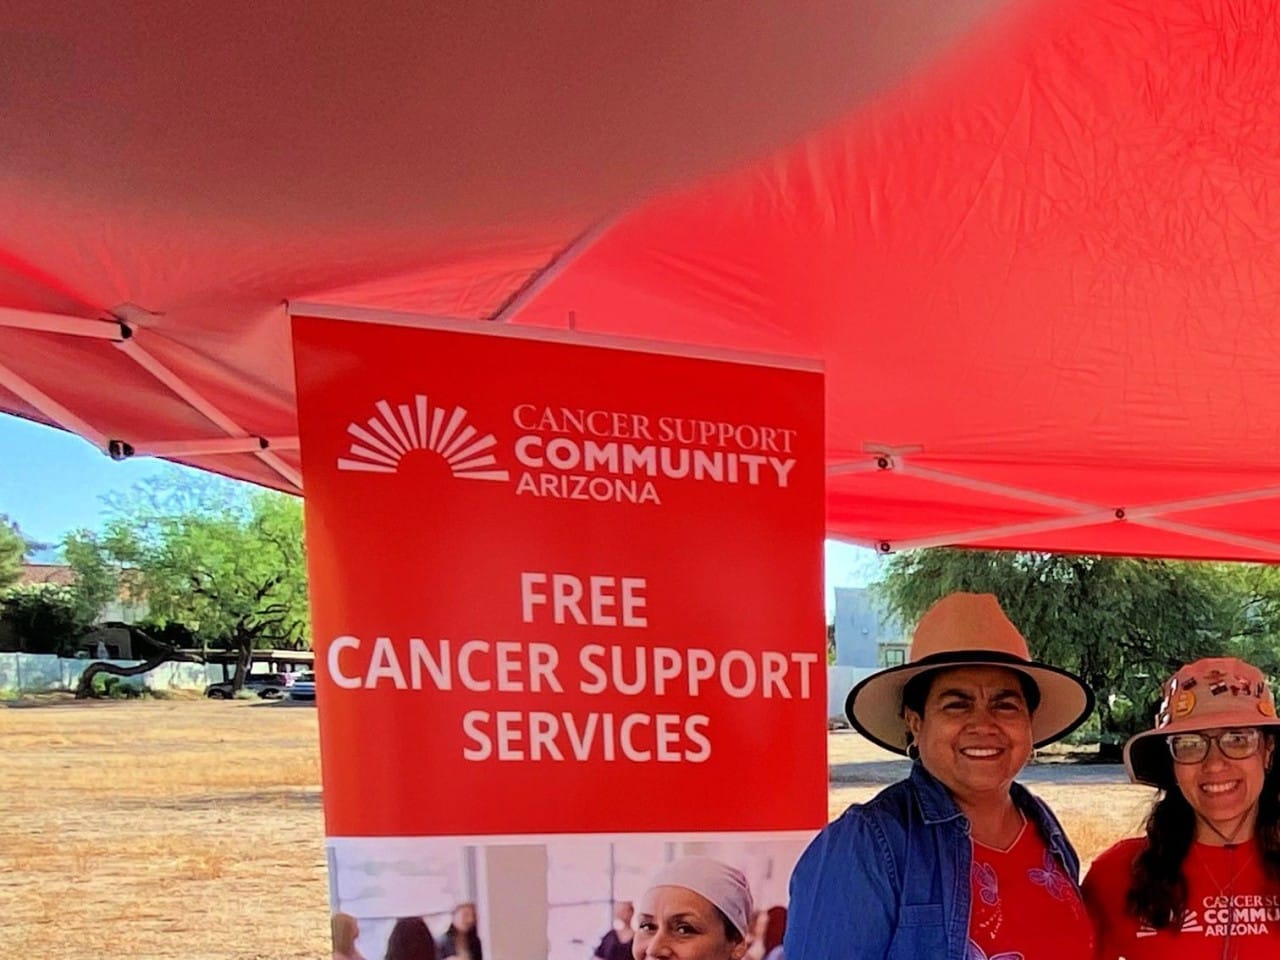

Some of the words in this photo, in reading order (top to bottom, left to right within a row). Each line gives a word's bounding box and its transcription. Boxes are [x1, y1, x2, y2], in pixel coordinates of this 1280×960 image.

[512, 403, 651, 441] CANCER
[658, 416, 797, 454] SUPPORT
[514, 435, 797, 488] COMMUNITY
[515, 472, 662, 504] ARIZONA
[520, 572, 648, 628] FREE
[326, 635, 564, 694] CANCER
[579, 644, 818, 700] SUPPORT
[462, 710, 712, 763] SERVICES
[1205, 923, 1269, 936] ARIZONA
